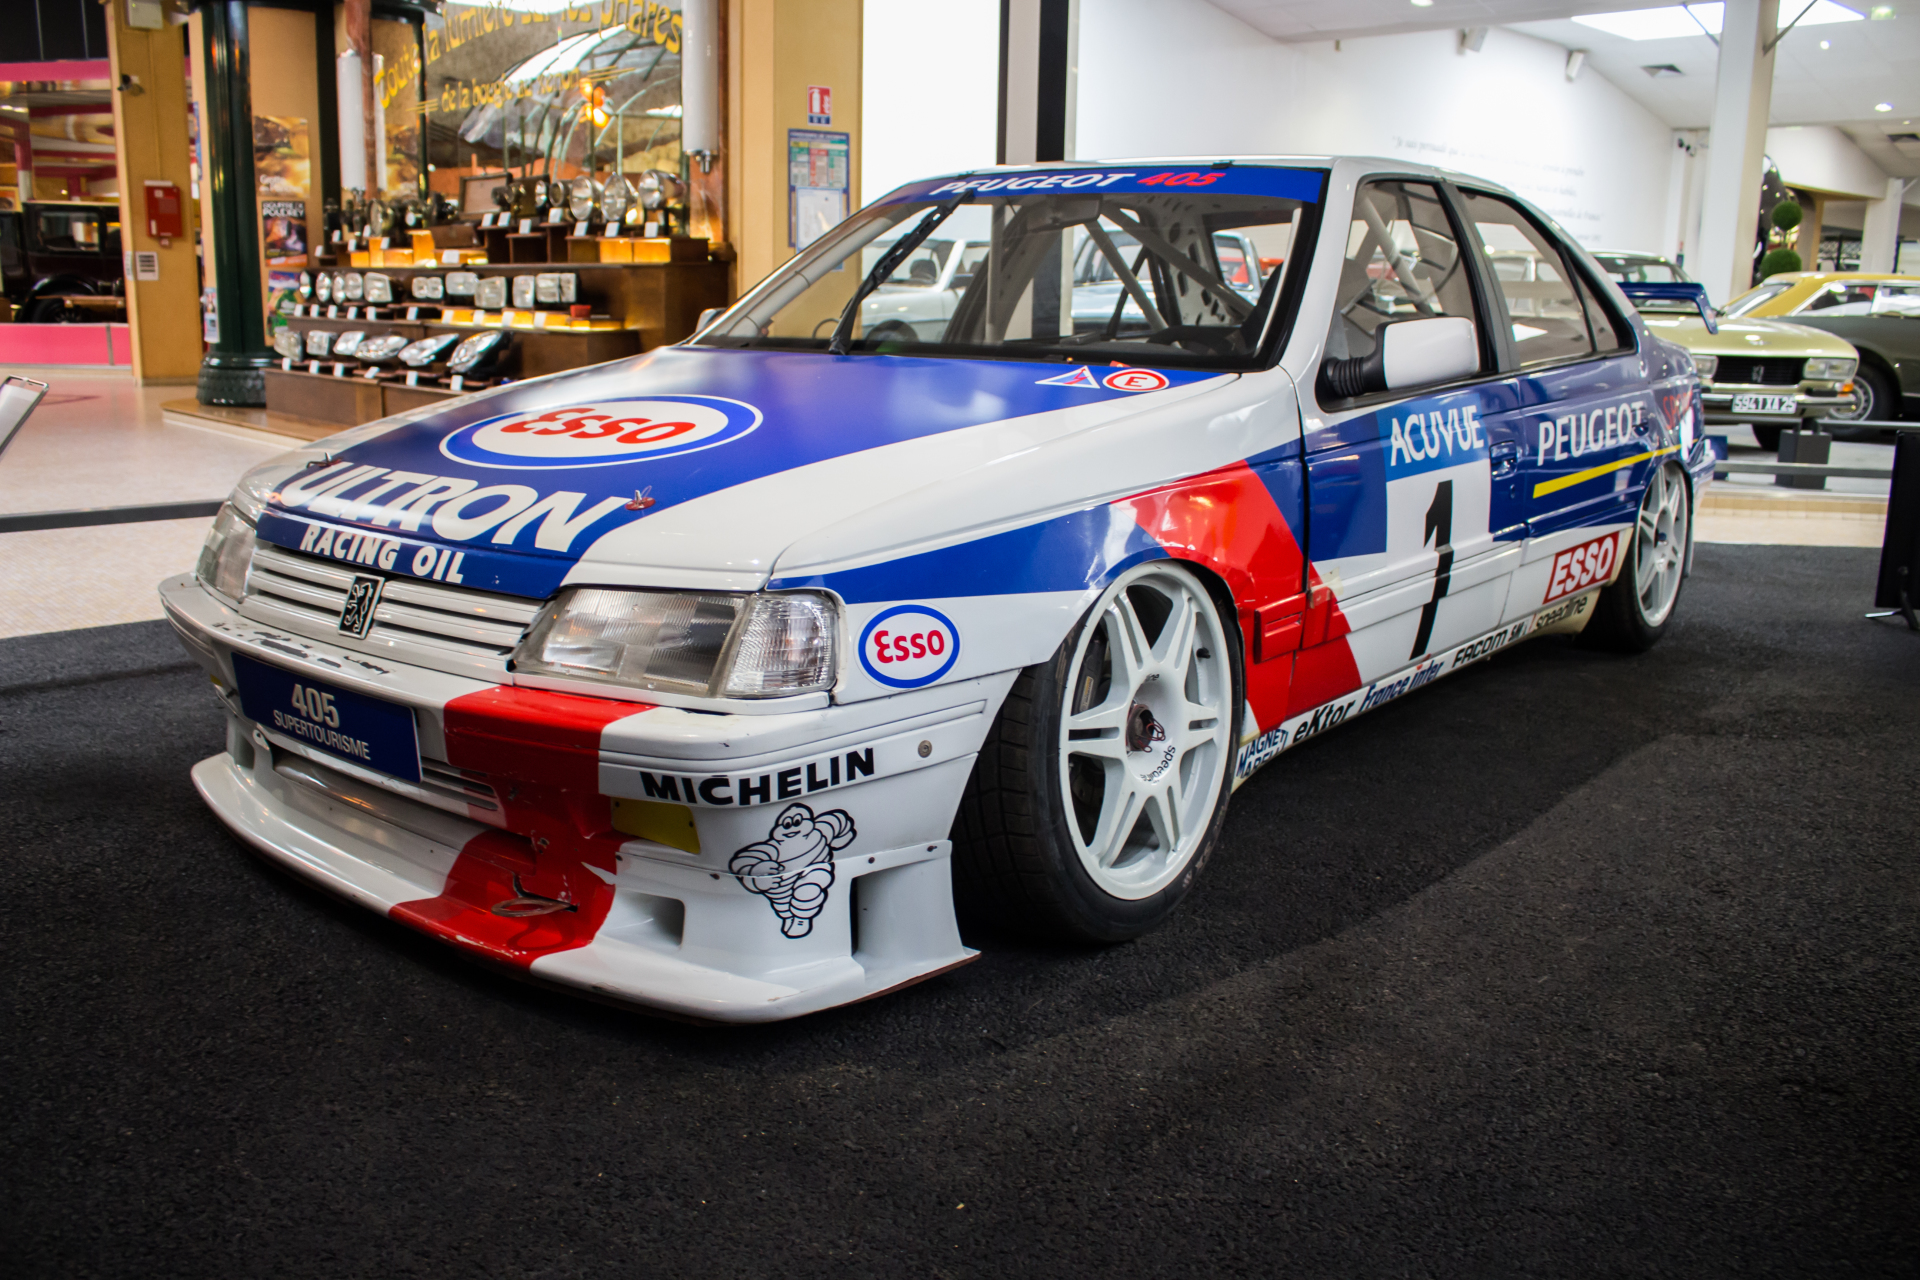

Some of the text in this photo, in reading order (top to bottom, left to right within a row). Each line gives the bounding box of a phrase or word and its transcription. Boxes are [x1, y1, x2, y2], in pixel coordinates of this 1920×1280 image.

[929, 172, 1227, 195] PEUGEOT 405
[1124, 376, 1148, 388] E
[1390, 405, 1485, 466] ACUVUE
[1537, 401, 1647, 466] PEUGEOT
[280, 462, 632, 552] ULTRON
[301, 524, 464, 583] RACING OIL
[1410, 479, 1454, 660] 1
[1546, 536, 1615, 602] ESSO
[291, 683, 340, 729] 405
[1358, 683, 1411, 713] France
[273, 709, 371, 761] SUPERTOURISME
[639, 748, 876, 806] MICHELIN
